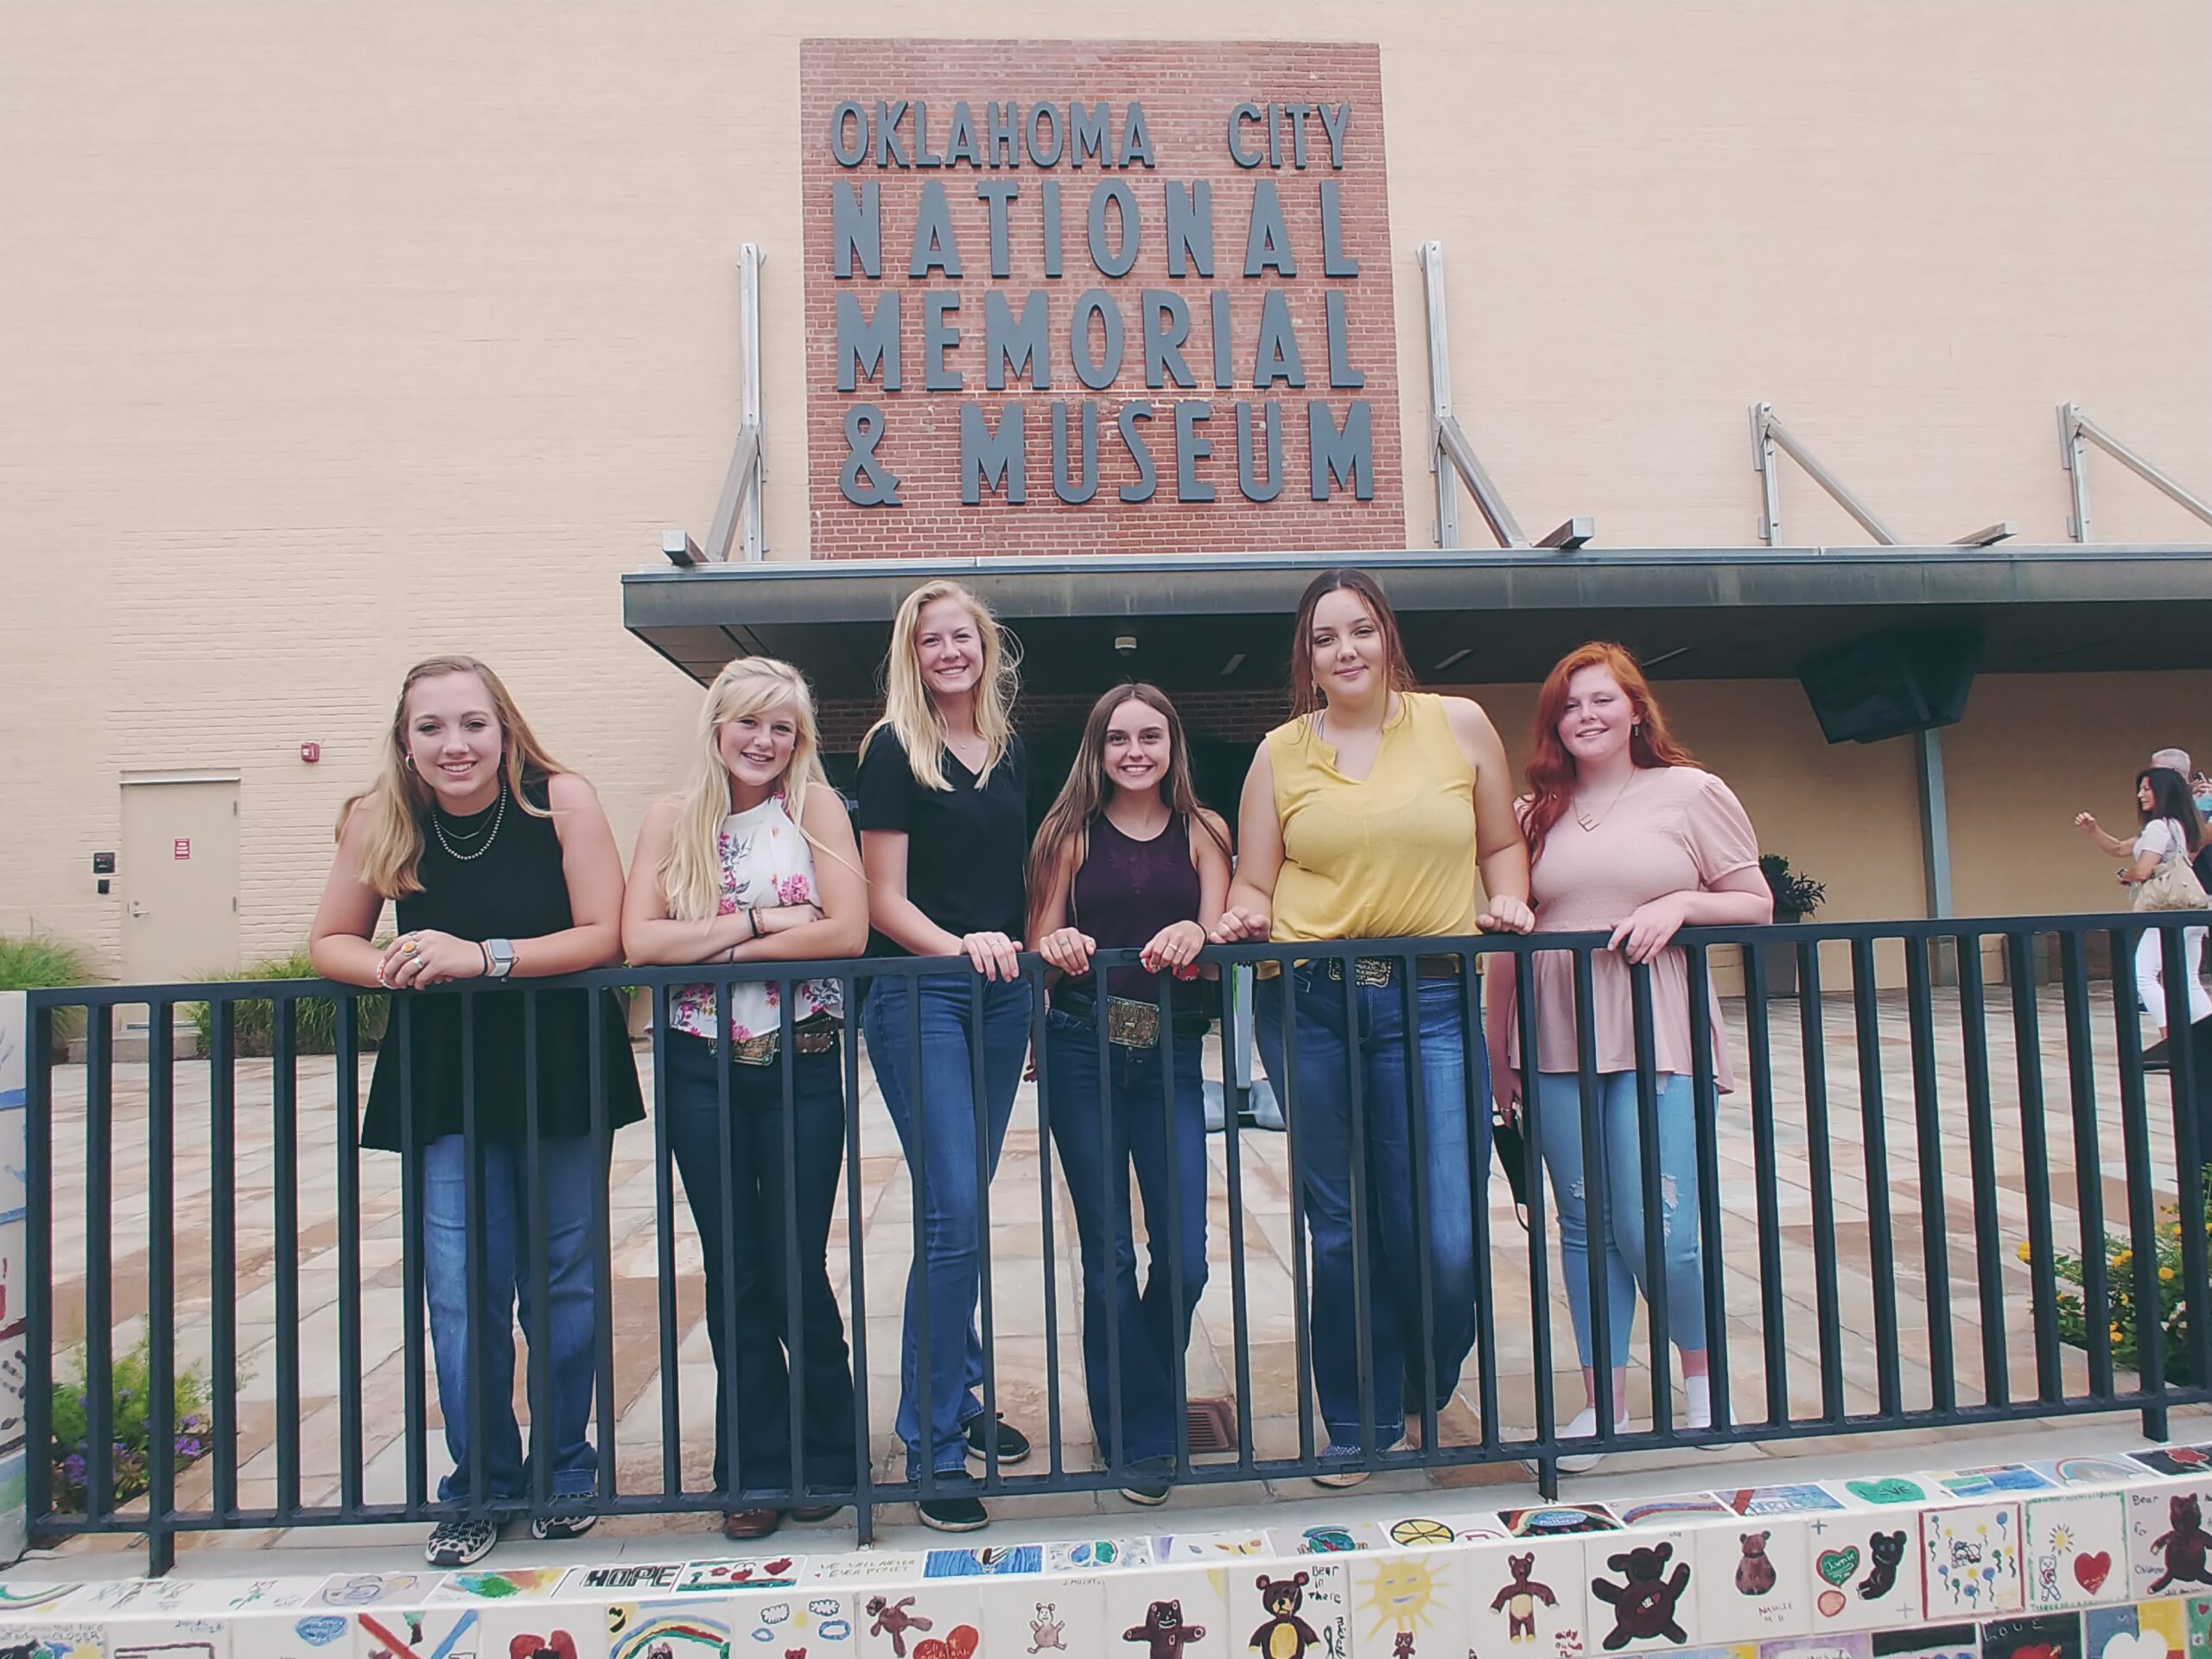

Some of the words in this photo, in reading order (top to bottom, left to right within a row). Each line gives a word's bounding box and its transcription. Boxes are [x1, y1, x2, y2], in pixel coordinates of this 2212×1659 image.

[830, 100, 1155, 169] OKLAHOMA
[1227, 102, 1351, 170] CITY
[831, 177, 1359, 279] NATIONAL
[835, 288, 1365, 392] MEMORIAL
[839, 402, 902, 506] &
[960, 399, 1374, 505] MUSEUM
[583, 1565, 682, 1587] HOPE
[1312, 1566, 1340, 1577] Bear
[1314, 1578, 1325, 1589] in
